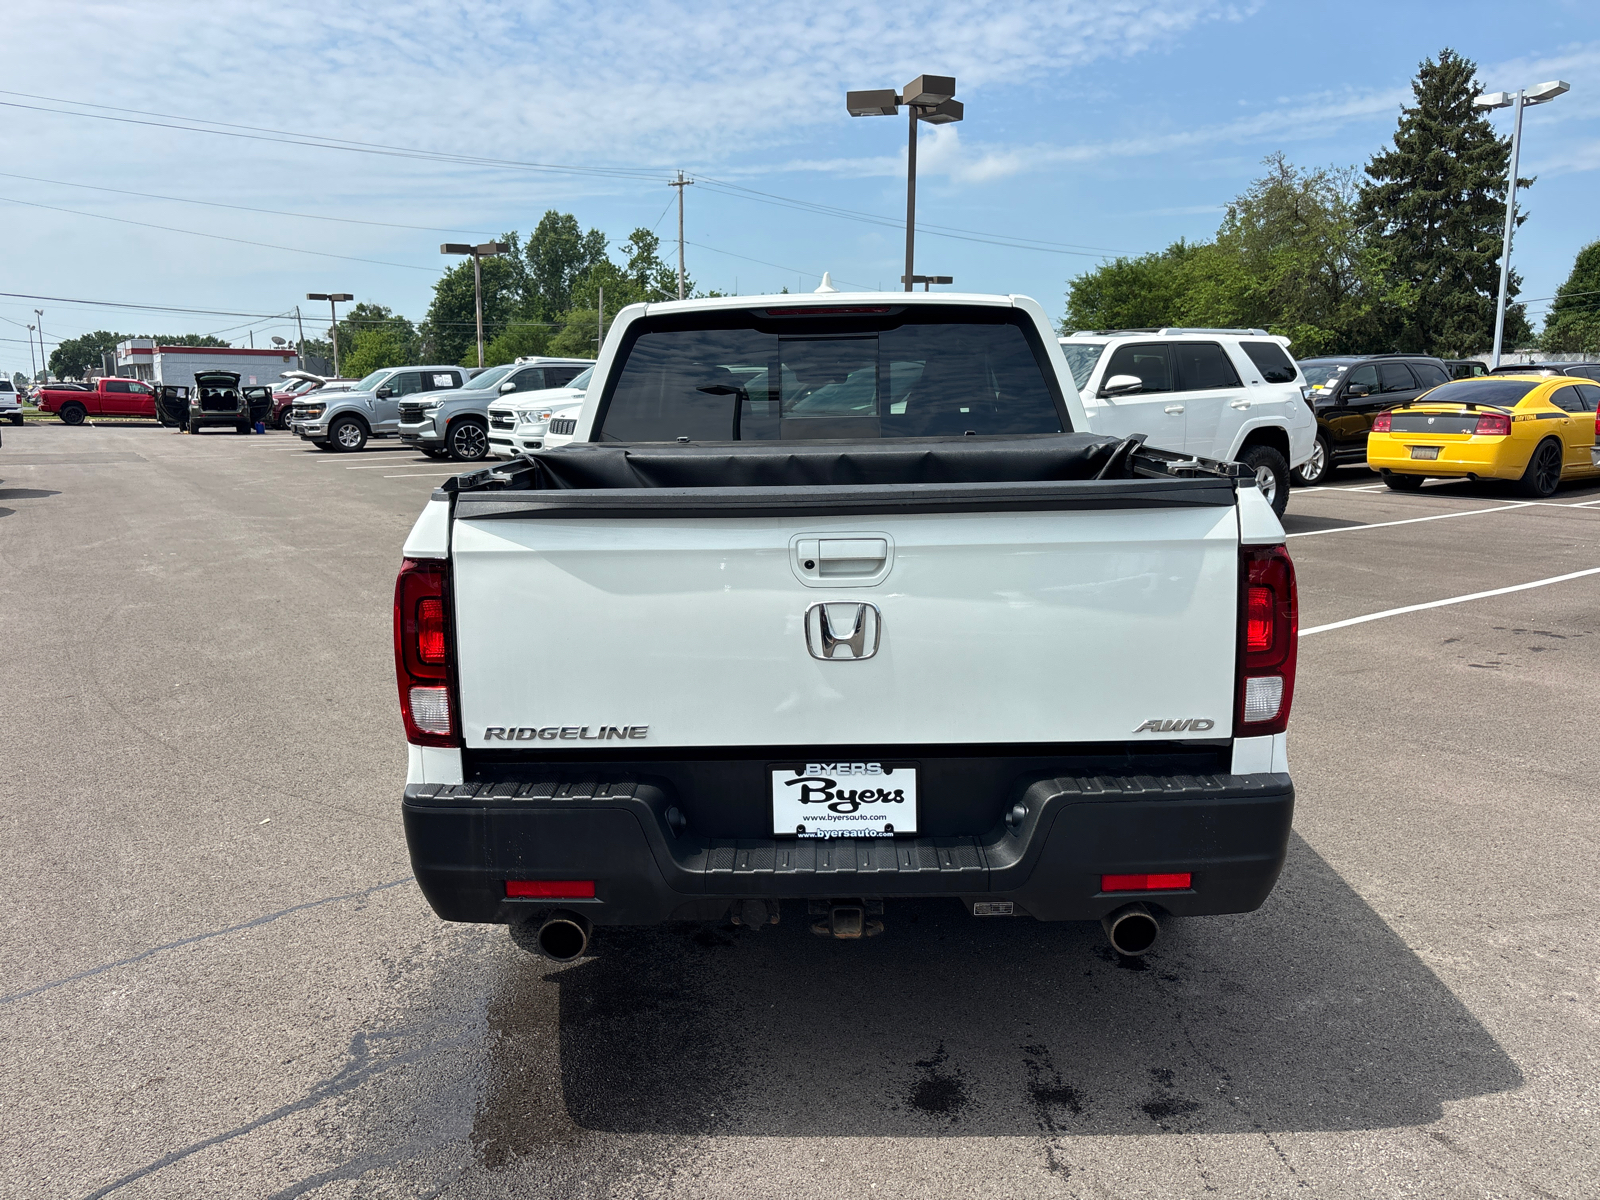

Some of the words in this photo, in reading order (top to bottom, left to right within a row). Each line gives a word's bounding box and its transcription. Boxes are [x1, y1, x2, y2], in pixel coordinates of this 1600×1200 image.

[484, 725, 649, 741] RIDGELINE
[1132, 718, 1215, 733] AWD
[805, 762, 883, 777] BYERS
[784, 776, 905, 814] Byers
[803, 813, 887, 822] www.byersauto.com
[797, 828, 894, 840] www.byersauto.com
